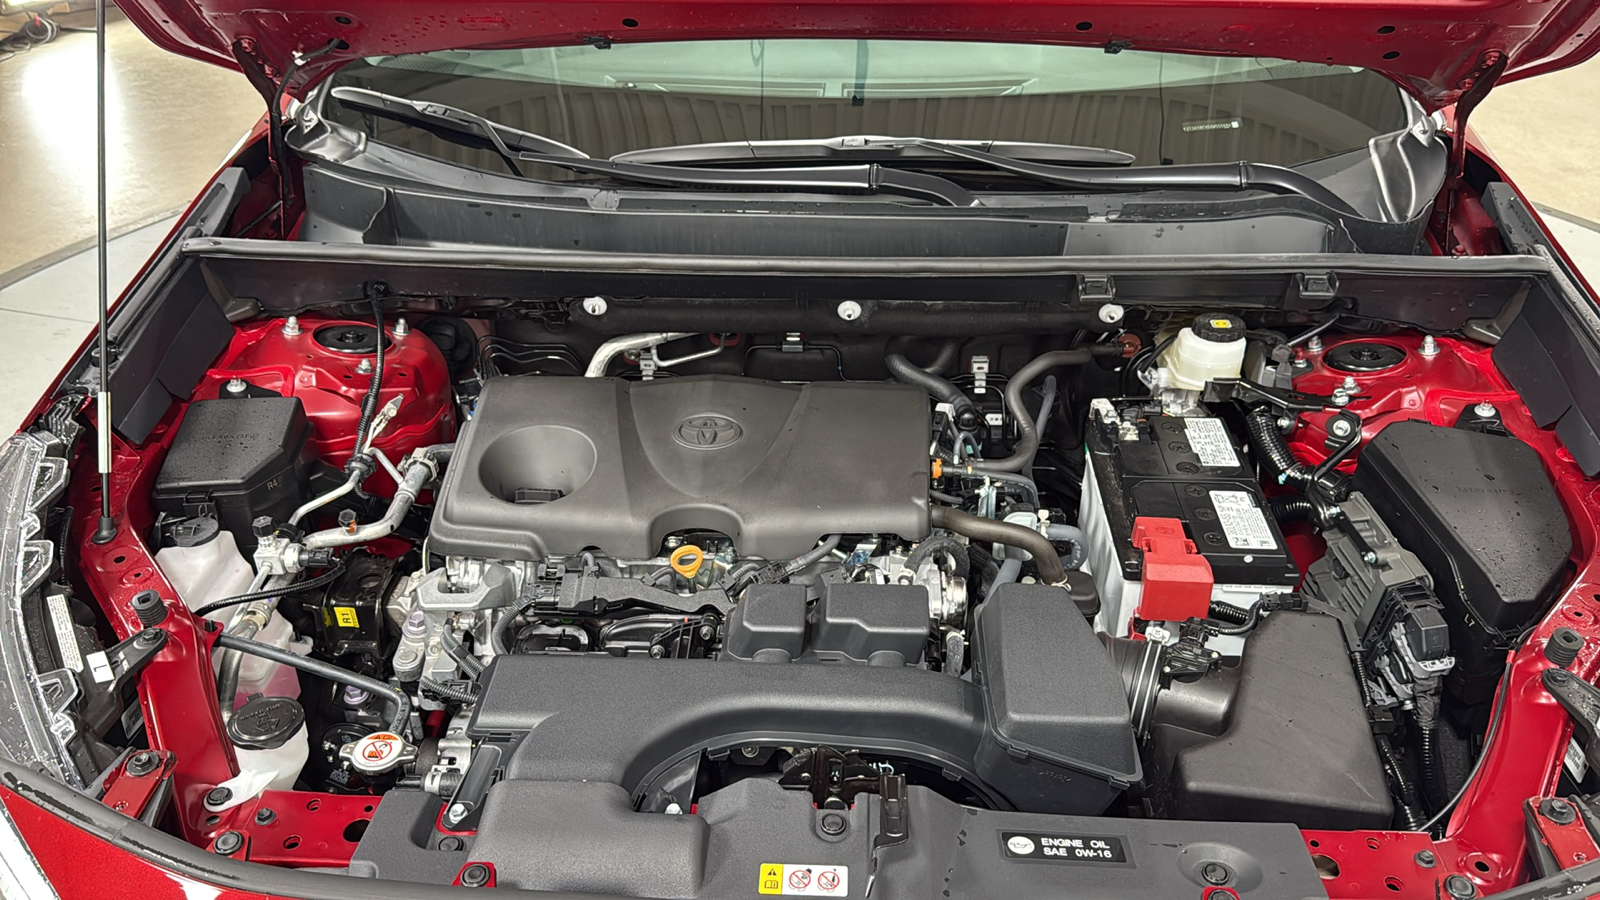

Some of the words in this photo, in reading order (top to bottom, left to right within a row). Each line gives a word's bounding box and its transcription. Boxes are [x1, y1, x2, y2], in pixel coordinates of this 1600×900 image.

[266, 479, 278, 491] R4
[341, 612, 352, 624] R1
[1464, 613, 1475, 627] L7
[1041, 837, 1083, 847] ENGINE
[1090, 840, 1110, 848] OIL
[1043, 847, 1068, 856] SAE
[1075, 849, 1112, 858] 0W-16
